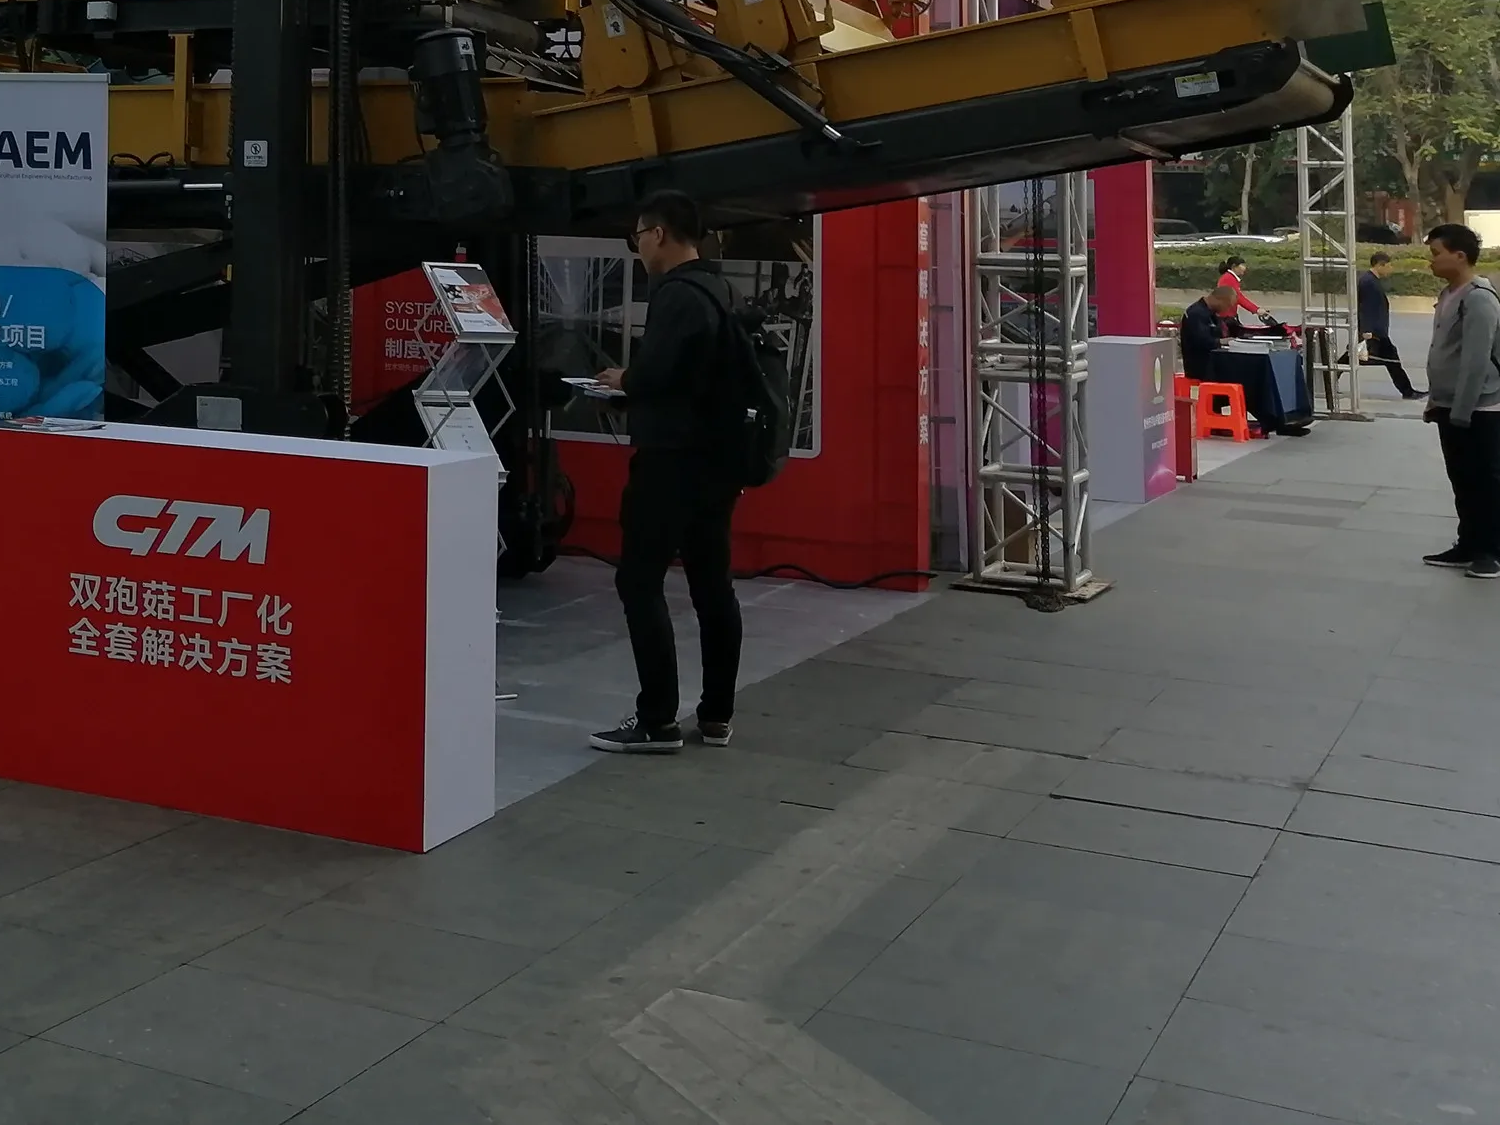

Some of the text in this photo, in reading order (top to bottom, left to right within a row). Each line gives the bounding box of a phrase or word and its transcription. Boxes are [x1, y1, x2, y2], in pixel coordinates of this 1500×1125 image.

[21, 173, 52, 181] Engineering
[53, 174, 93, 182] Manufacturing
[92, 494, 270, 565] GTM
[69, 572, 293, 636] 双孢菇工厂化
[69, 617, 292, 684] 全套解决方案
